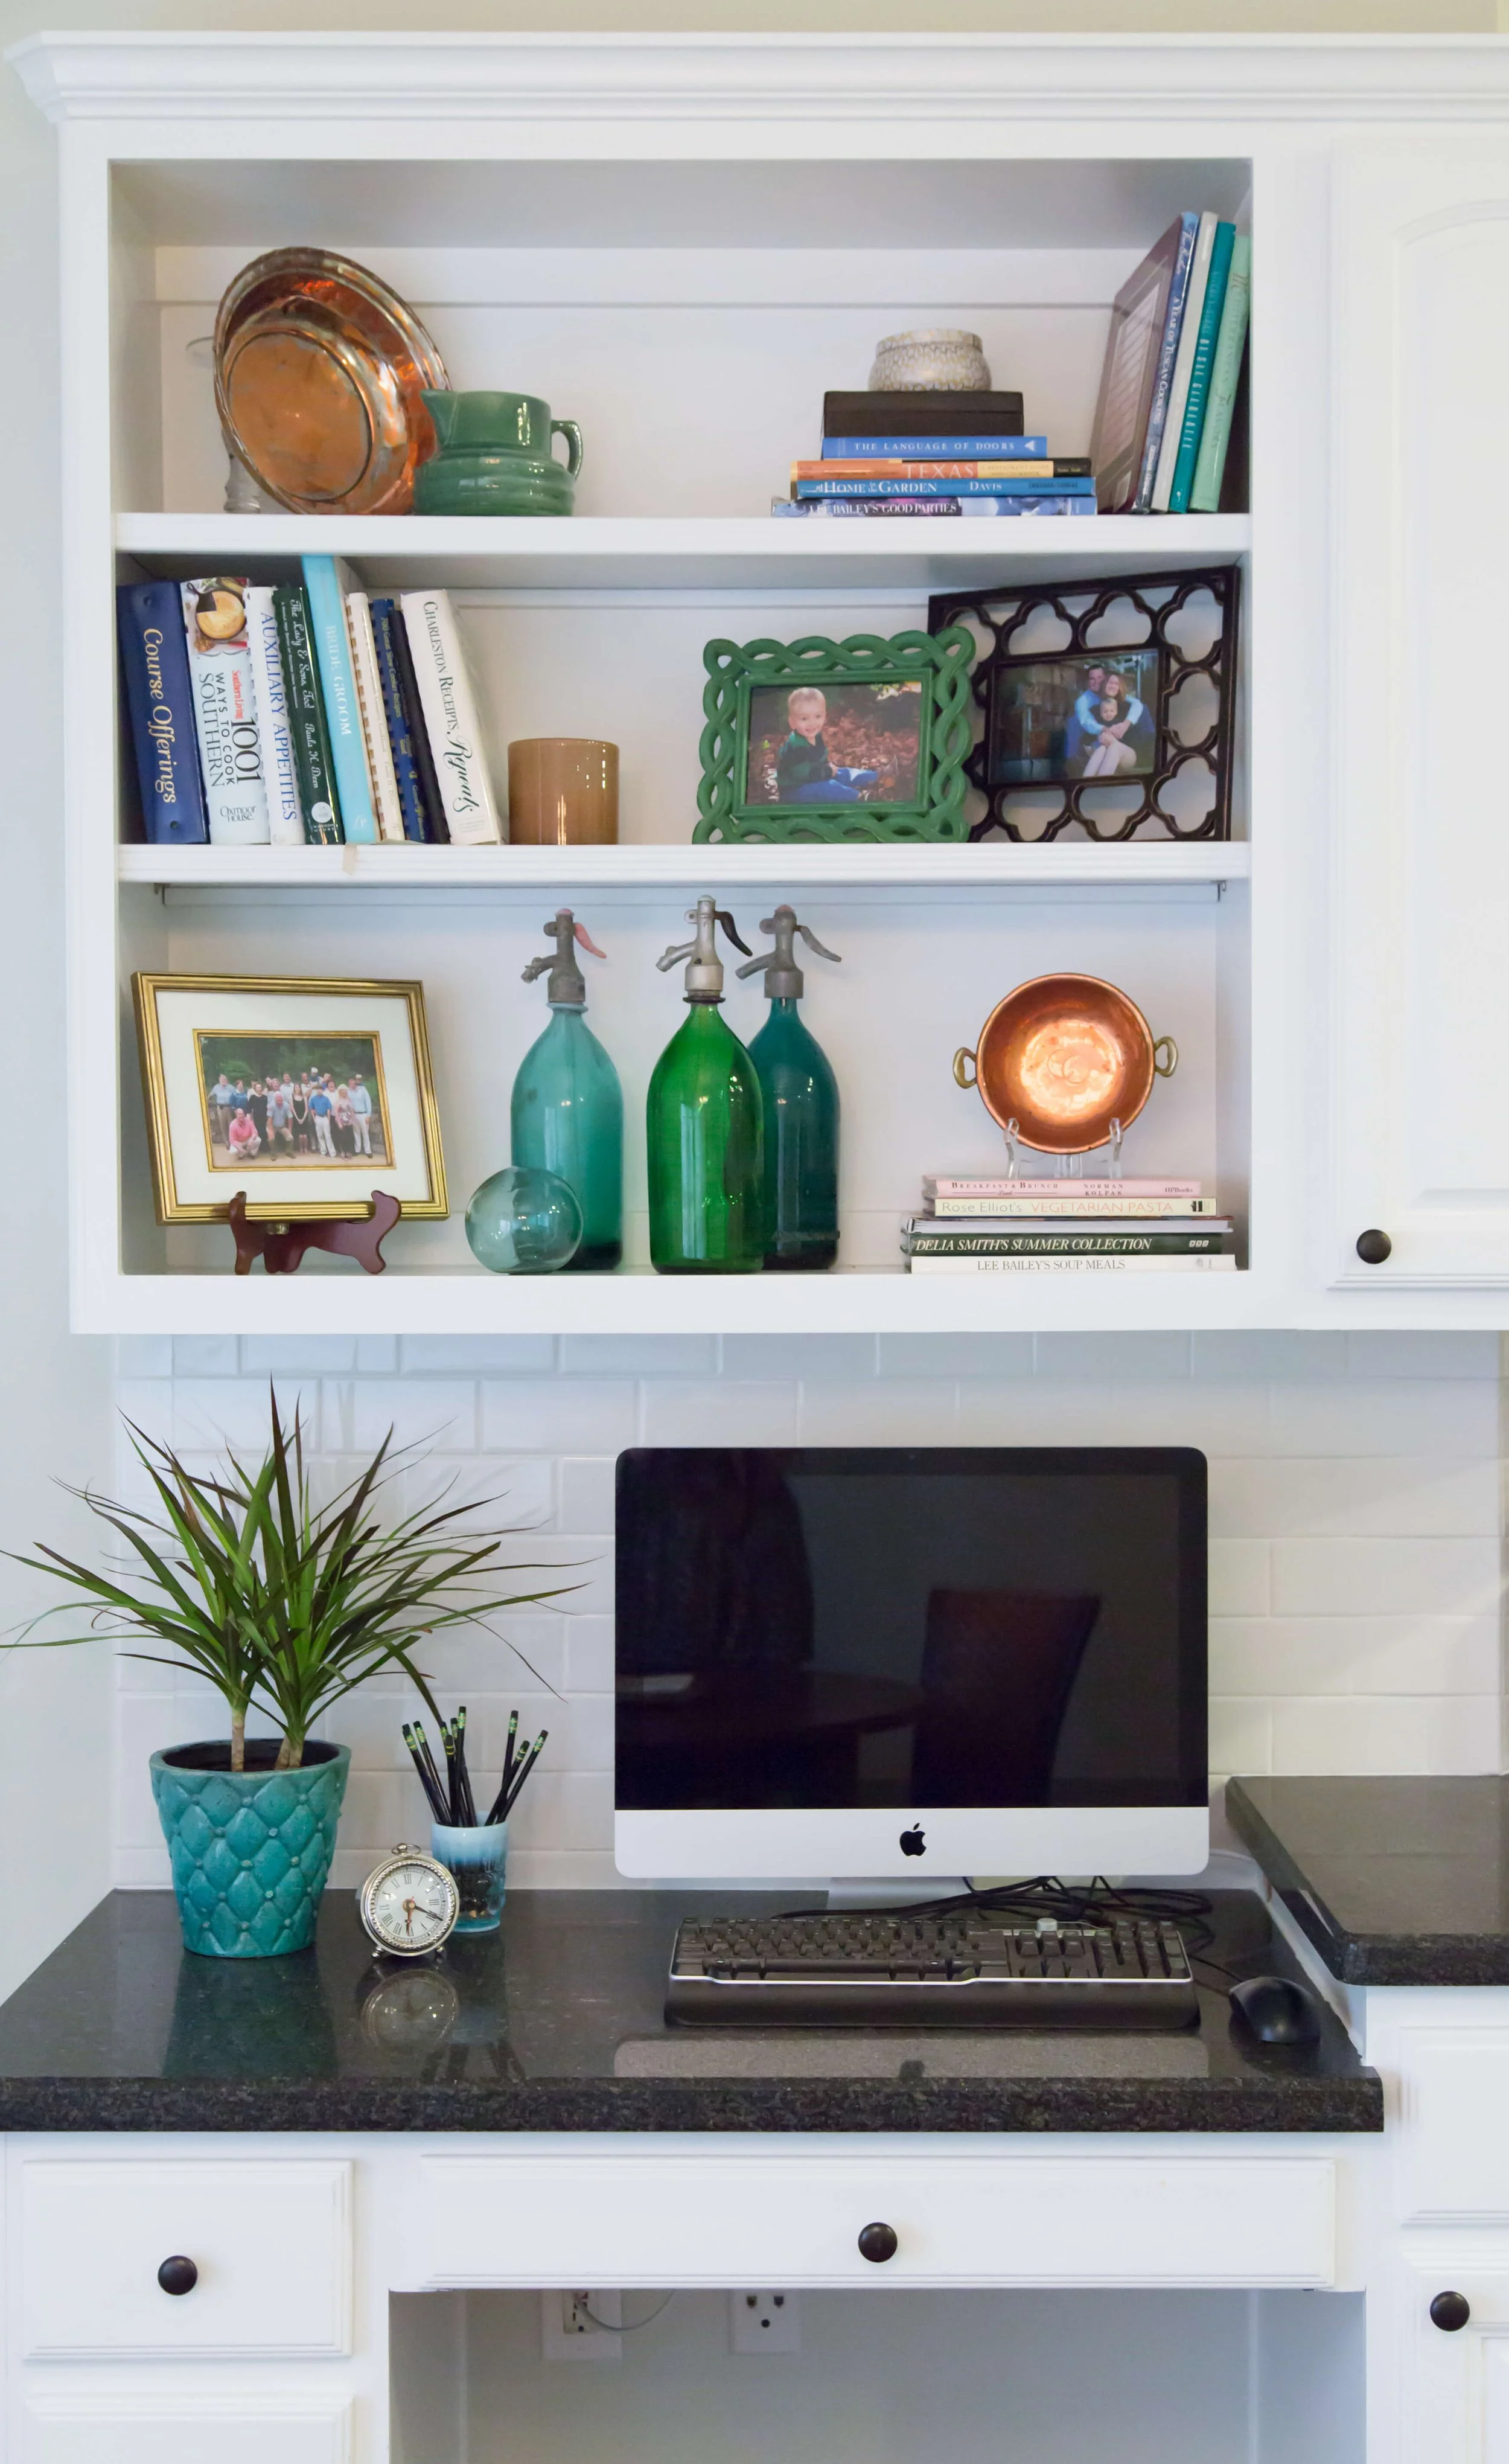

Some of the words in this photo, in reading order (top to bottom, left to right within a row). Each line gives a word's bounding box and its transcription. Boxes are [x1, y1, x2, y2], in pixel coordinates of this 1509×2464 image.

[884, 441, 947, 450] LANGUAGE
[954, 441, 970, 450] OF
[976, 441, 1015, 450] DOORS
[902, 463, 974, 479] TEXAS
[824, 481, 866, 493] HOME
[878, 480, 937, 493] GARDEN
[834, 504, 878, 514] BAILEY'S
[882, 503, 913, 513] GOOD
[914, 502, 957, 513] PARTIES
[290, 599, 302, 618] The
[291, 621, 305, 646] Lady
[423, 601, 448, 673] CHARLESTON
[144, 629, 164, 700] Course
[261, 612, 286, 717] AUXILIARY
[297, 650, 308, 659] &
[215, 672, 228, 712] WAYS
[302, 690, 314, 708] Too!
[333, 676, 353, 735] GROOM
[199, 673, 225, 787] SOUTHERN
[220, 720, 230, 738] TO
[147, 705, 177, 804] Offerings
[231, 717, 262, 785] 1001
[304, 723, 317, 747] Paula
[311, 766, 322, 789] Deen
[223, 745, 235, 786] COOK
[273, 723, 297, 821] APPETITES
[942, 1202, 975, 1212] Rose
[980, 1202, 1022, 1213] Elliot's
[1031, 1202, 1123, 1212] VEGETARIAN
[1128, 1202, 1173, 1212] PASTA
[915, 1240, 954, 1251] DELIA
[957, 1238, 1010, 1250] SMITH'S
[1011, 1238, 1070, 1250] SUMMER
[1071, 1238, 1152, 1250] COLLECTION
[977, 1261, 999, 1270] LEE
[1003, 1259, 1050, 1270] BAILEY'S
[1053, 1259, 1083, 1270] SOUP
[1086, 1259, 1125, 1270] MEALS
